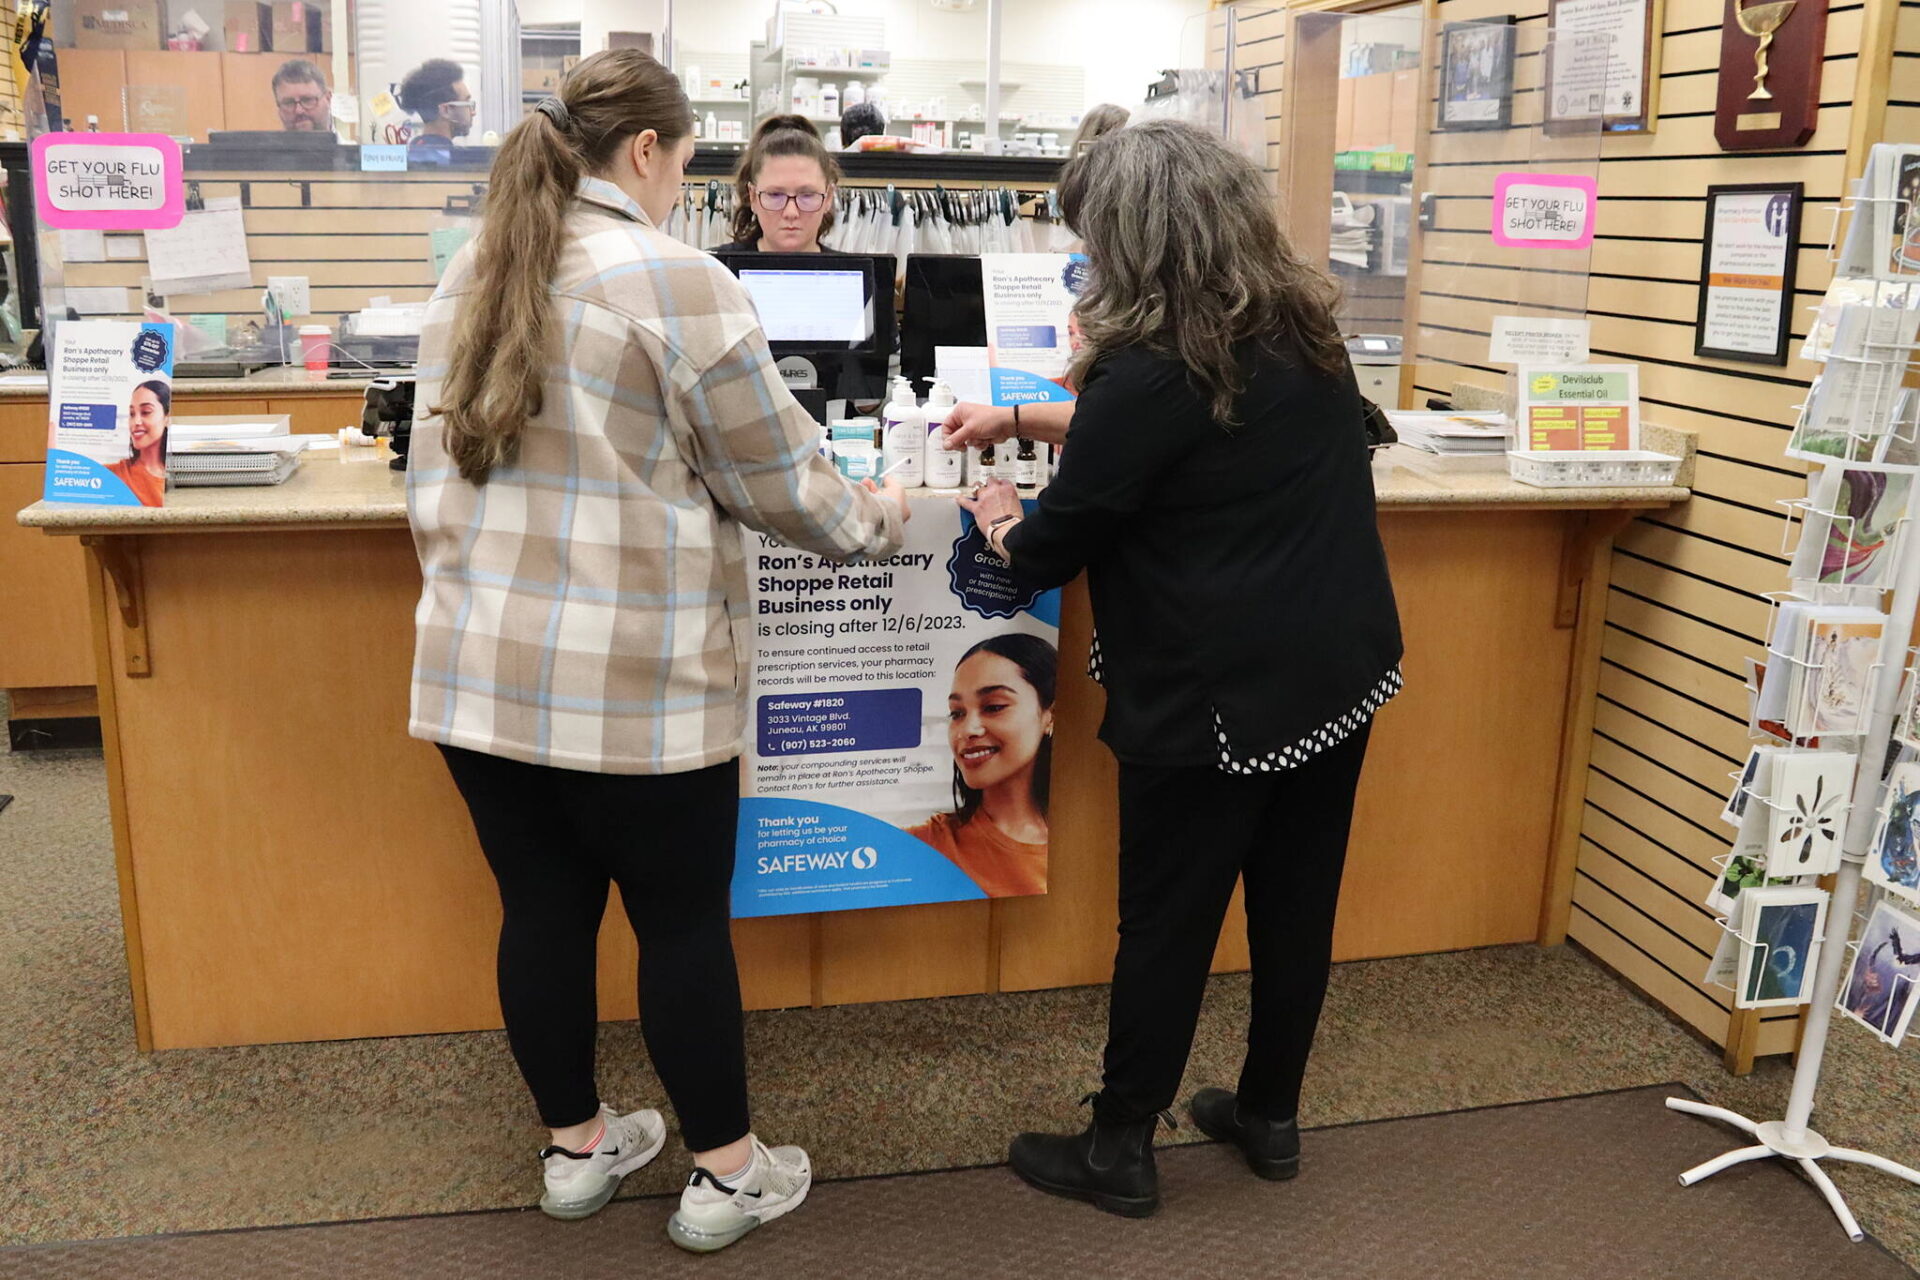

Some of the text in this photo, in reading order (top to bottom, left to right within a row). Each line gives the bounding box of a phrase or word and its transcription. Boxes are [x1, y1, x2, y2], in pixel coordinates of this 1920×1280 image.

[47, 160, 160, 177] GET YOUR FLU
[59, 184, 153, 200] SHOT HERE!
[1505, 197, 1584, 212] GET YOUR FLU
[1510, 218, 1577, 232] SHOT HERE!
[1562, 374, 1604, 385] Devilsclub
[1001, 392, 1039, 401] SAFEWAY
[1559, 389, 1608, 399] Essential Oil
[53, 477, 90, 488] SAFEWAY
[758, 535, 786, 548] Yo
[758, 554, 813, 570] Ron's
[758, 572, 893, 596] Shoppe Retail
[979, 572, 995, 581] with
[978, 579, 1018, 594] transferred
[758, 595, 893, 615] Business only
[758, 613, 966, 638] is closing after 12/6/2023.
[758, 642, 930, 658] To ensure continued access to retail
[757, 657, 934, 674] prescription services, your pharmacy
[757, 670, 936, 685] records will be moved to this location:
[768, 698, 844, 711] Safeway #1820
[768, 712, 851, 724] 3033 Vintage Blvd.
[768, 723, 847, 735] Juneau, AK 99801
[781, 737, 856, 751] (907) 523-2060
[757, 756, 906, 773] Note: your compounding services will
[757, 774, 787, 782] remain
[798, 771, 820, 782] place
[833, 768, 853, 777] Ron's
[855, 765, 901, 777] Apothecary
[903, 765, 934, 774] Shoppe.
[757, 778, 899, 793] Contact Ron's for further assistance.
[758, 816, 819, 828] Thank you
[758, 830, 769, 838] for
[772, 828, 800, 838] letting
[814, 826, 826, 834] be
[828, 826, 848, 835] your
[758, 835, 847, 850] pharmacy of choice
[757, 851, 849, 874] SAFEWAY
